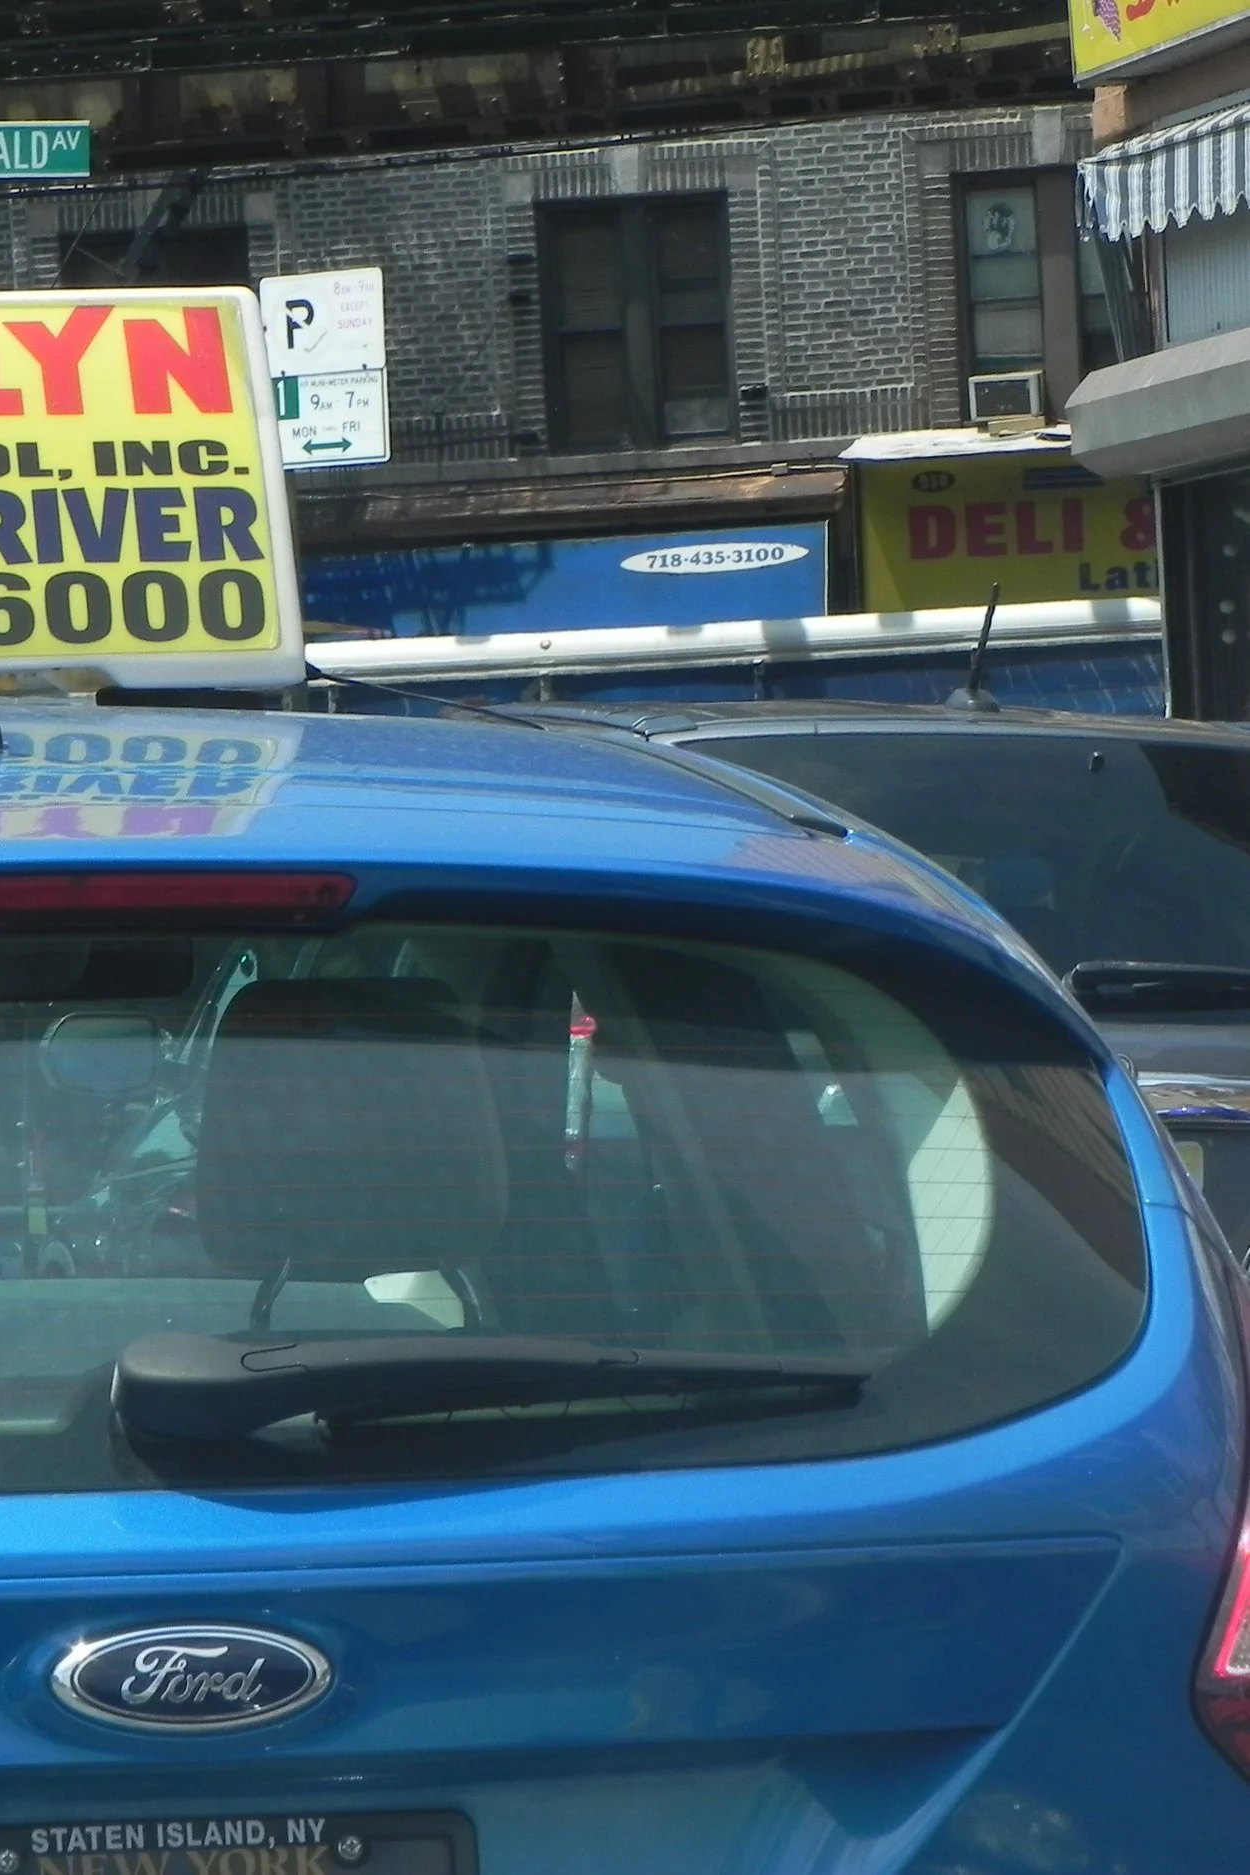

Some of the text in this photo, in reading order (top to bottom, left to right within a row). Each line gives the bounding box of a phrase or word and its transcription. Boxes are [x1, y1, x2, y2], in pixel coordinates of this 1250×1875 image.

[52, 130, 81, 150] AV
[337, 317, 373, 330] SUNDAY
[292, 426, 317, 439] MON
[342, 420, 361, 432] FRI
[92, 439, 250, 477] INC.
[908, 498, 1085, 560] DELI
[120, 1645, 266, 1705] Ford
[31, 1818, 326, 1854] STATEN ISLAND, NY
